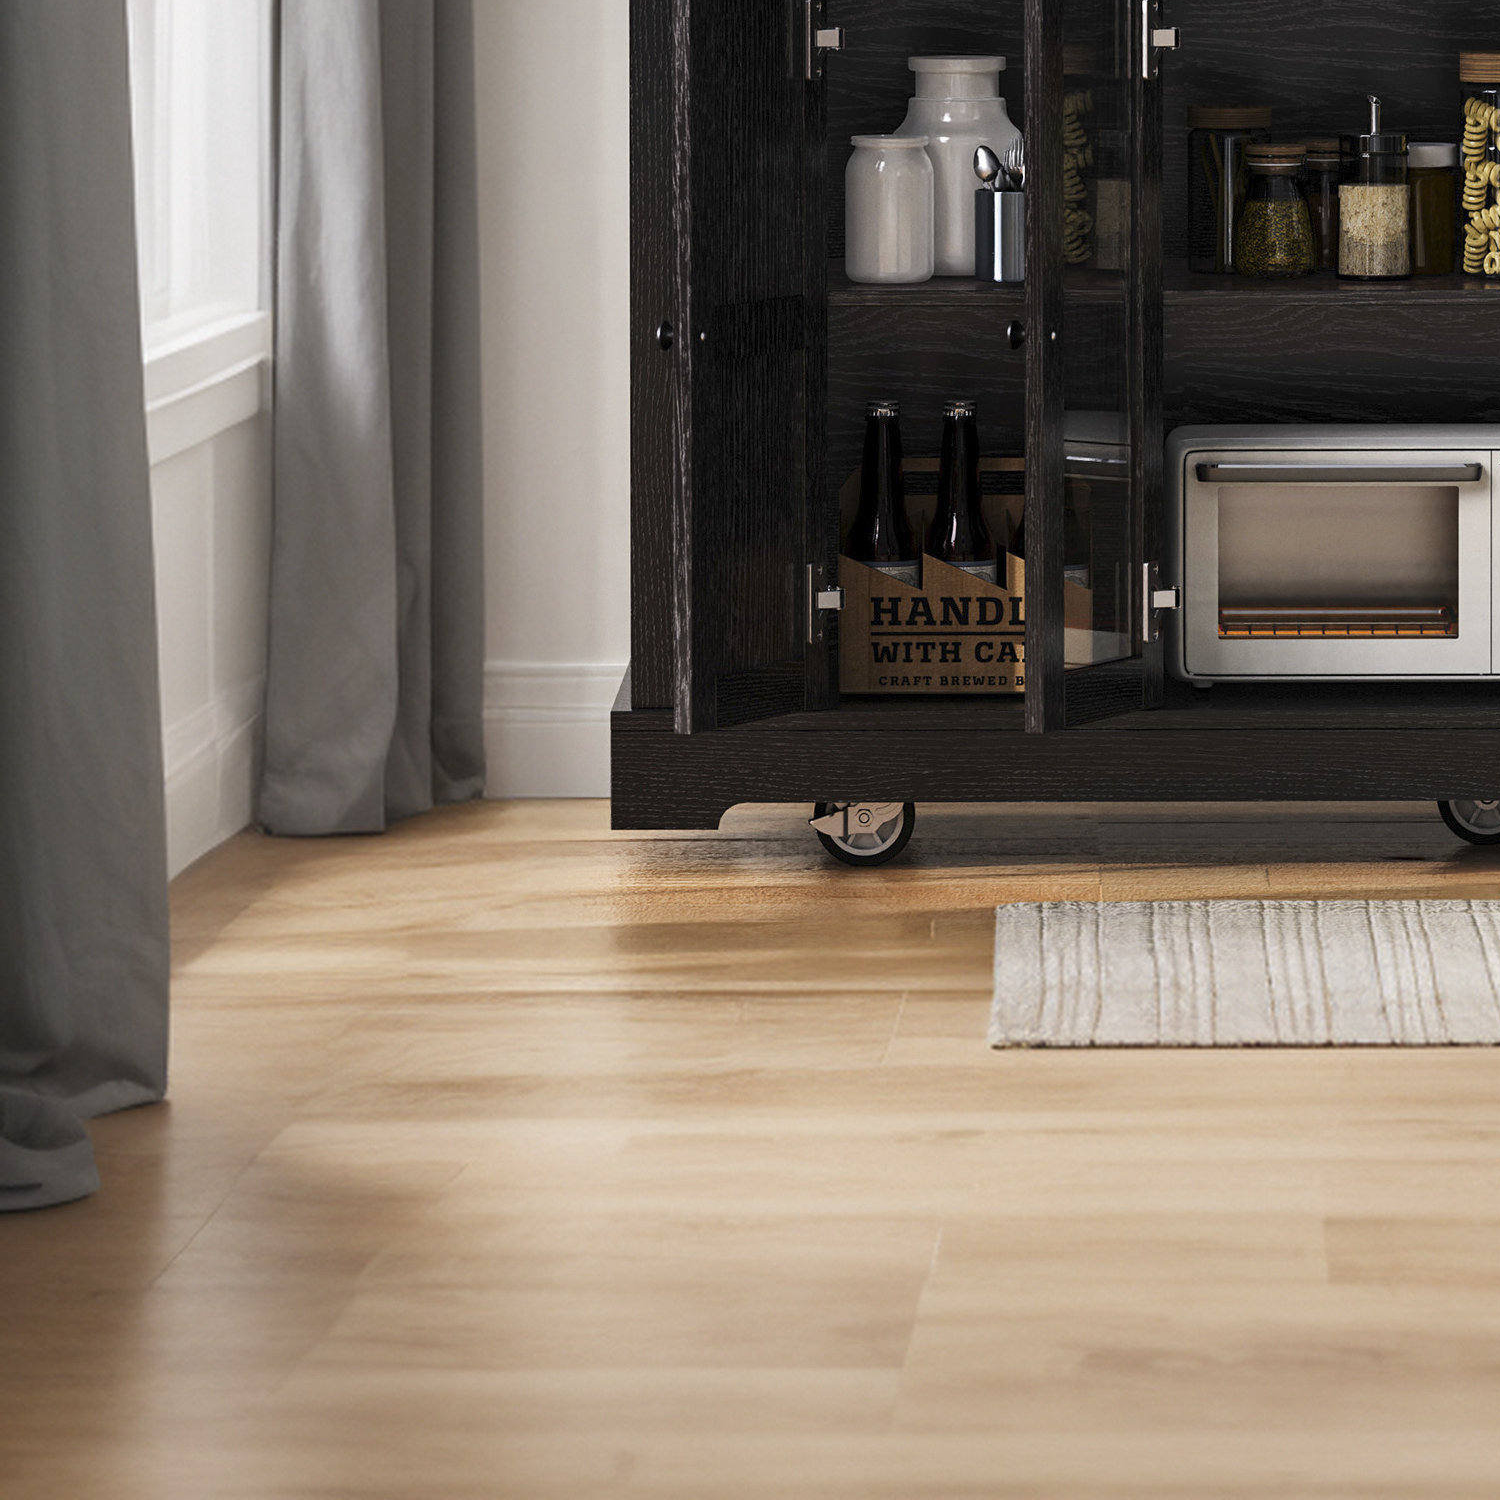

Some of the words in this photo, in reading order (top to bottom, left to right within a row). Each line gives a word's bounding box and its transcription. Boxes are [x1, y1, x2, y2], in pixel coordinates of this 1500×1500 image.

[870, 596, 1025, 626] HANDL
[871, 641, 962, 664] WITH
[974, 641, 1025, 664] CA
[878, 675, 932, 687] CRAFT
[939, 675, 1008, 687] BREWED
